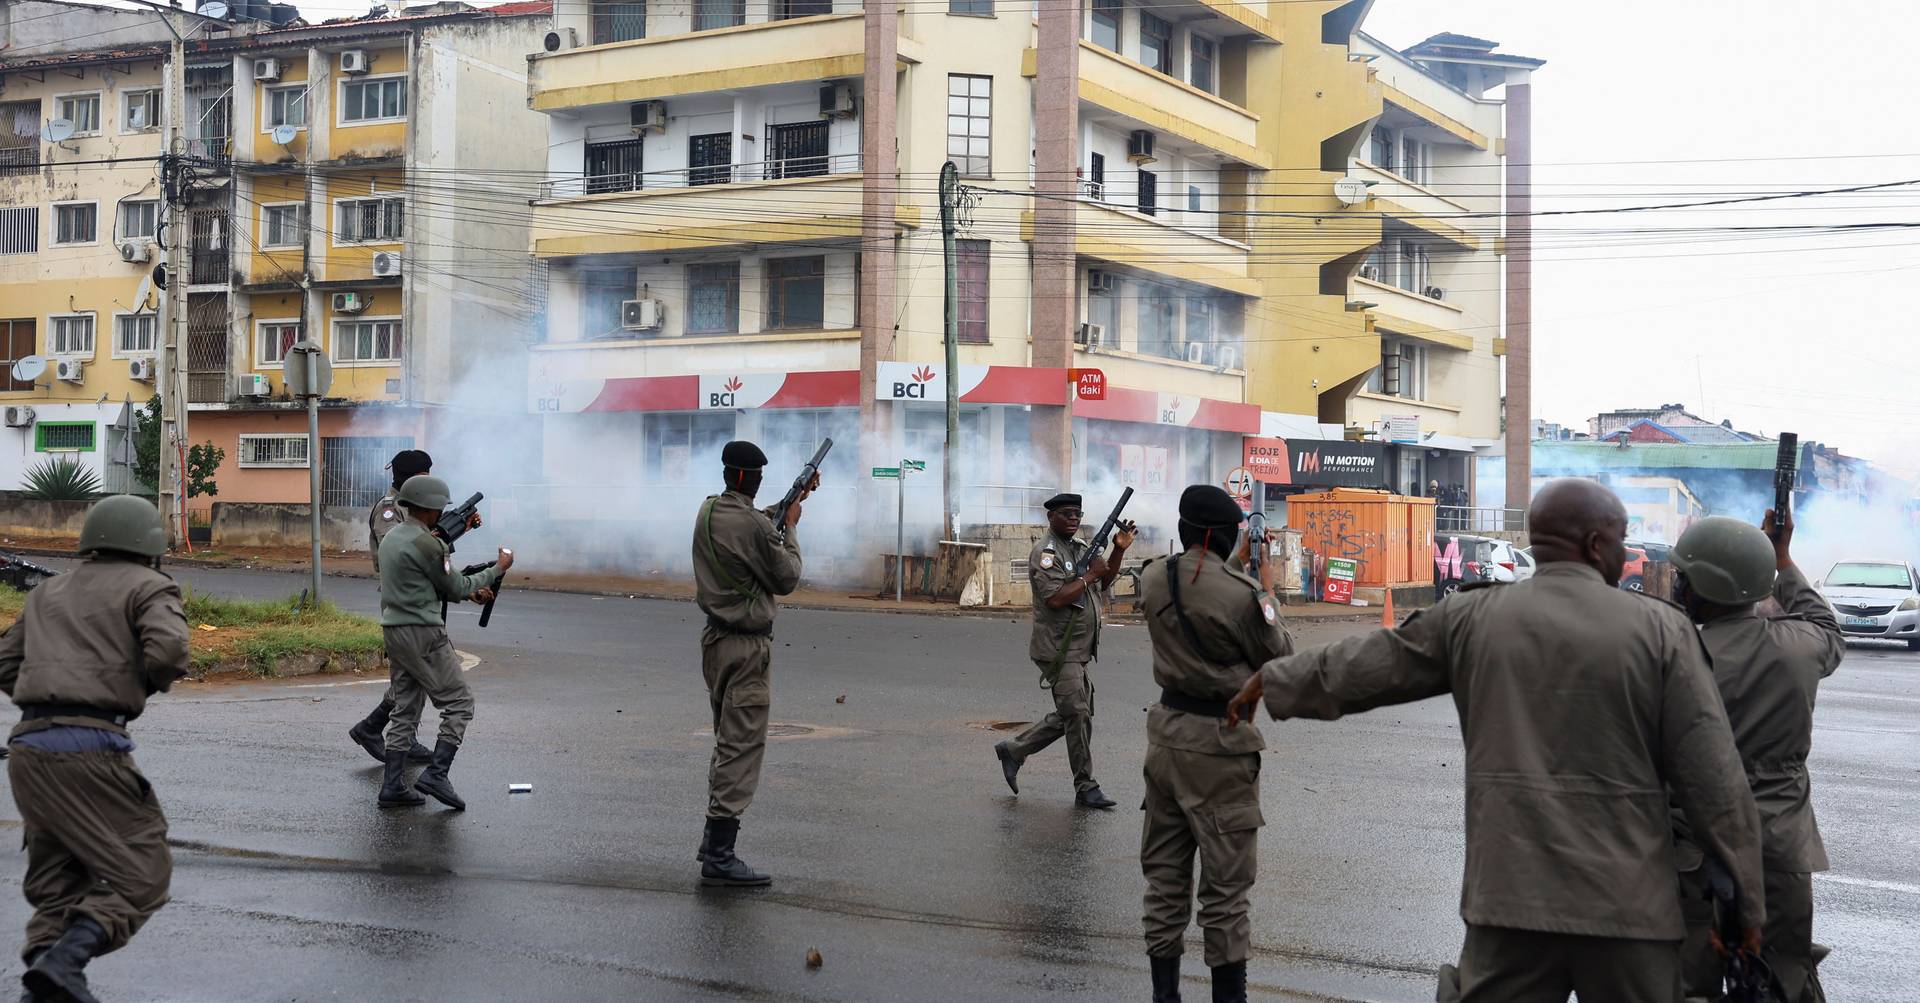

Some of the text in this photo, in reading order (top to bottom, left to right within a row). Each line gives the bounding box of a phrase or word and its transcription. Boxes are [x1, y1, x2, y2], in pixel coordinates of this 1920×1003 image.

[1081, 374, 1100, 383] ATM
[893, 382, 925, 398] BCI
[1081, 385, 1100, 394] daki
[538, 398, 560, 411] BCI
[710, 392, 734, 407] BCI
[1162, 409, 1176, 424] BCI
[1250, 446, 1279, 456] HOJE
[1256, 457, 1270, 465] DIA
[1323, 455, 1375, 466] IN MOTION
[1250, 464, 1280, 476] TREINO
